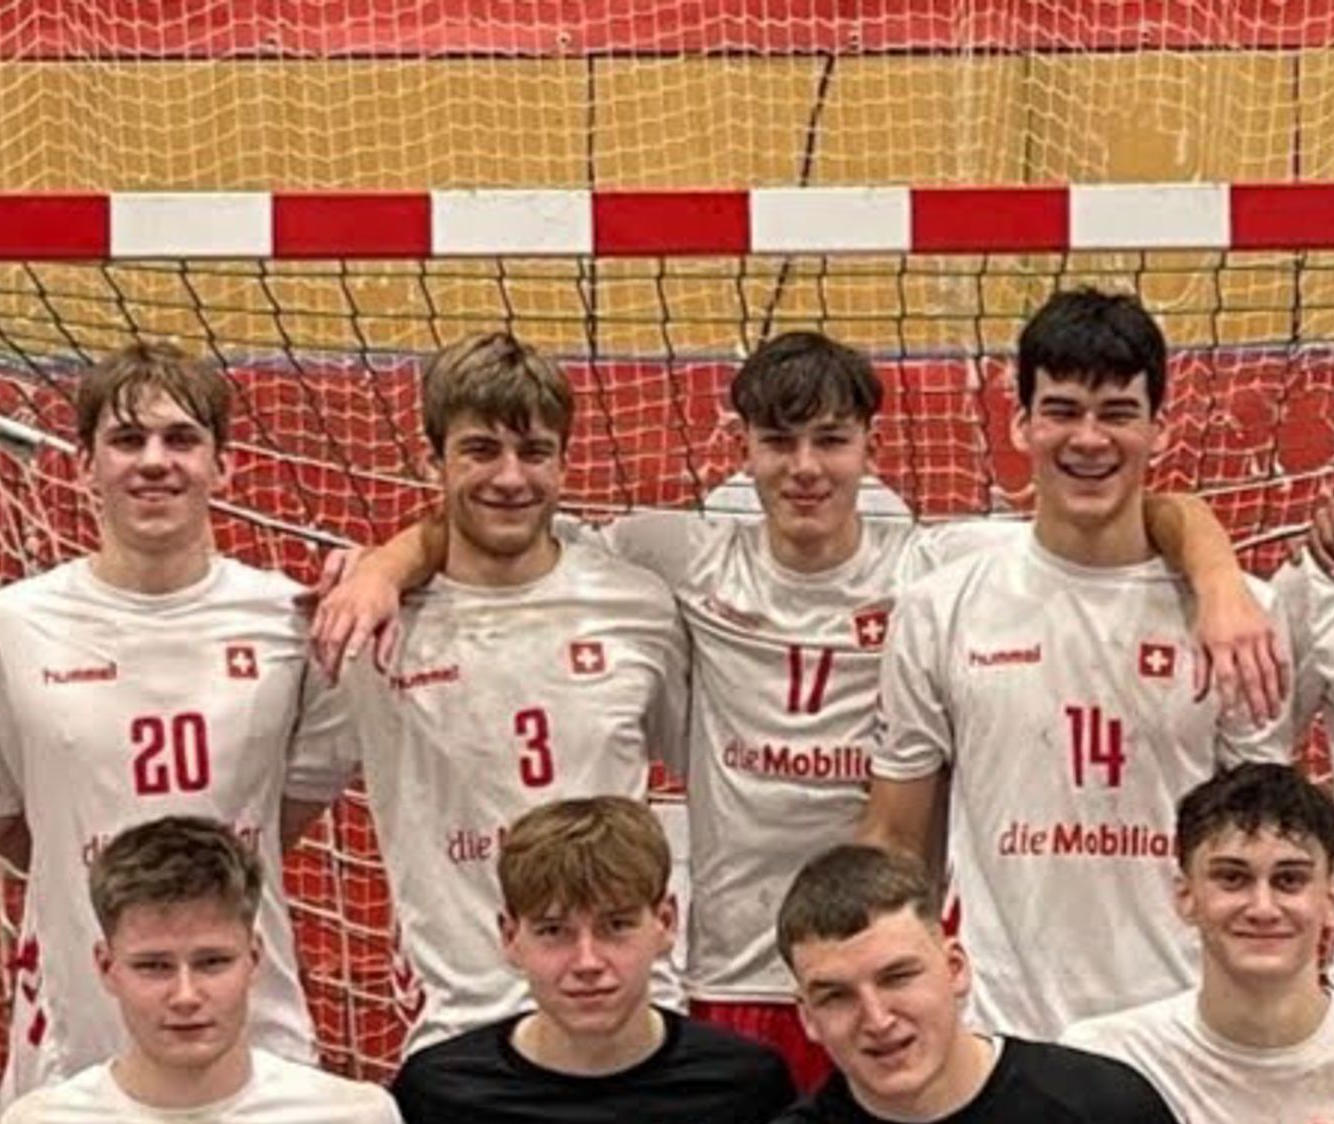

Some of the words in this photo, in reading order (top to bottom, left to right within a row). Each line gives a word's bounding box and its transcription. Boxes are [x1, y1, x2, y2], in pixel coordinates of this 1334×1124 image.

[131, 712, 210, 796] 20
[514, 708, 555, 788] 3
[1065, 706, 1126, 788] 14
[1051, 823, 1178, 857] Mobilia
